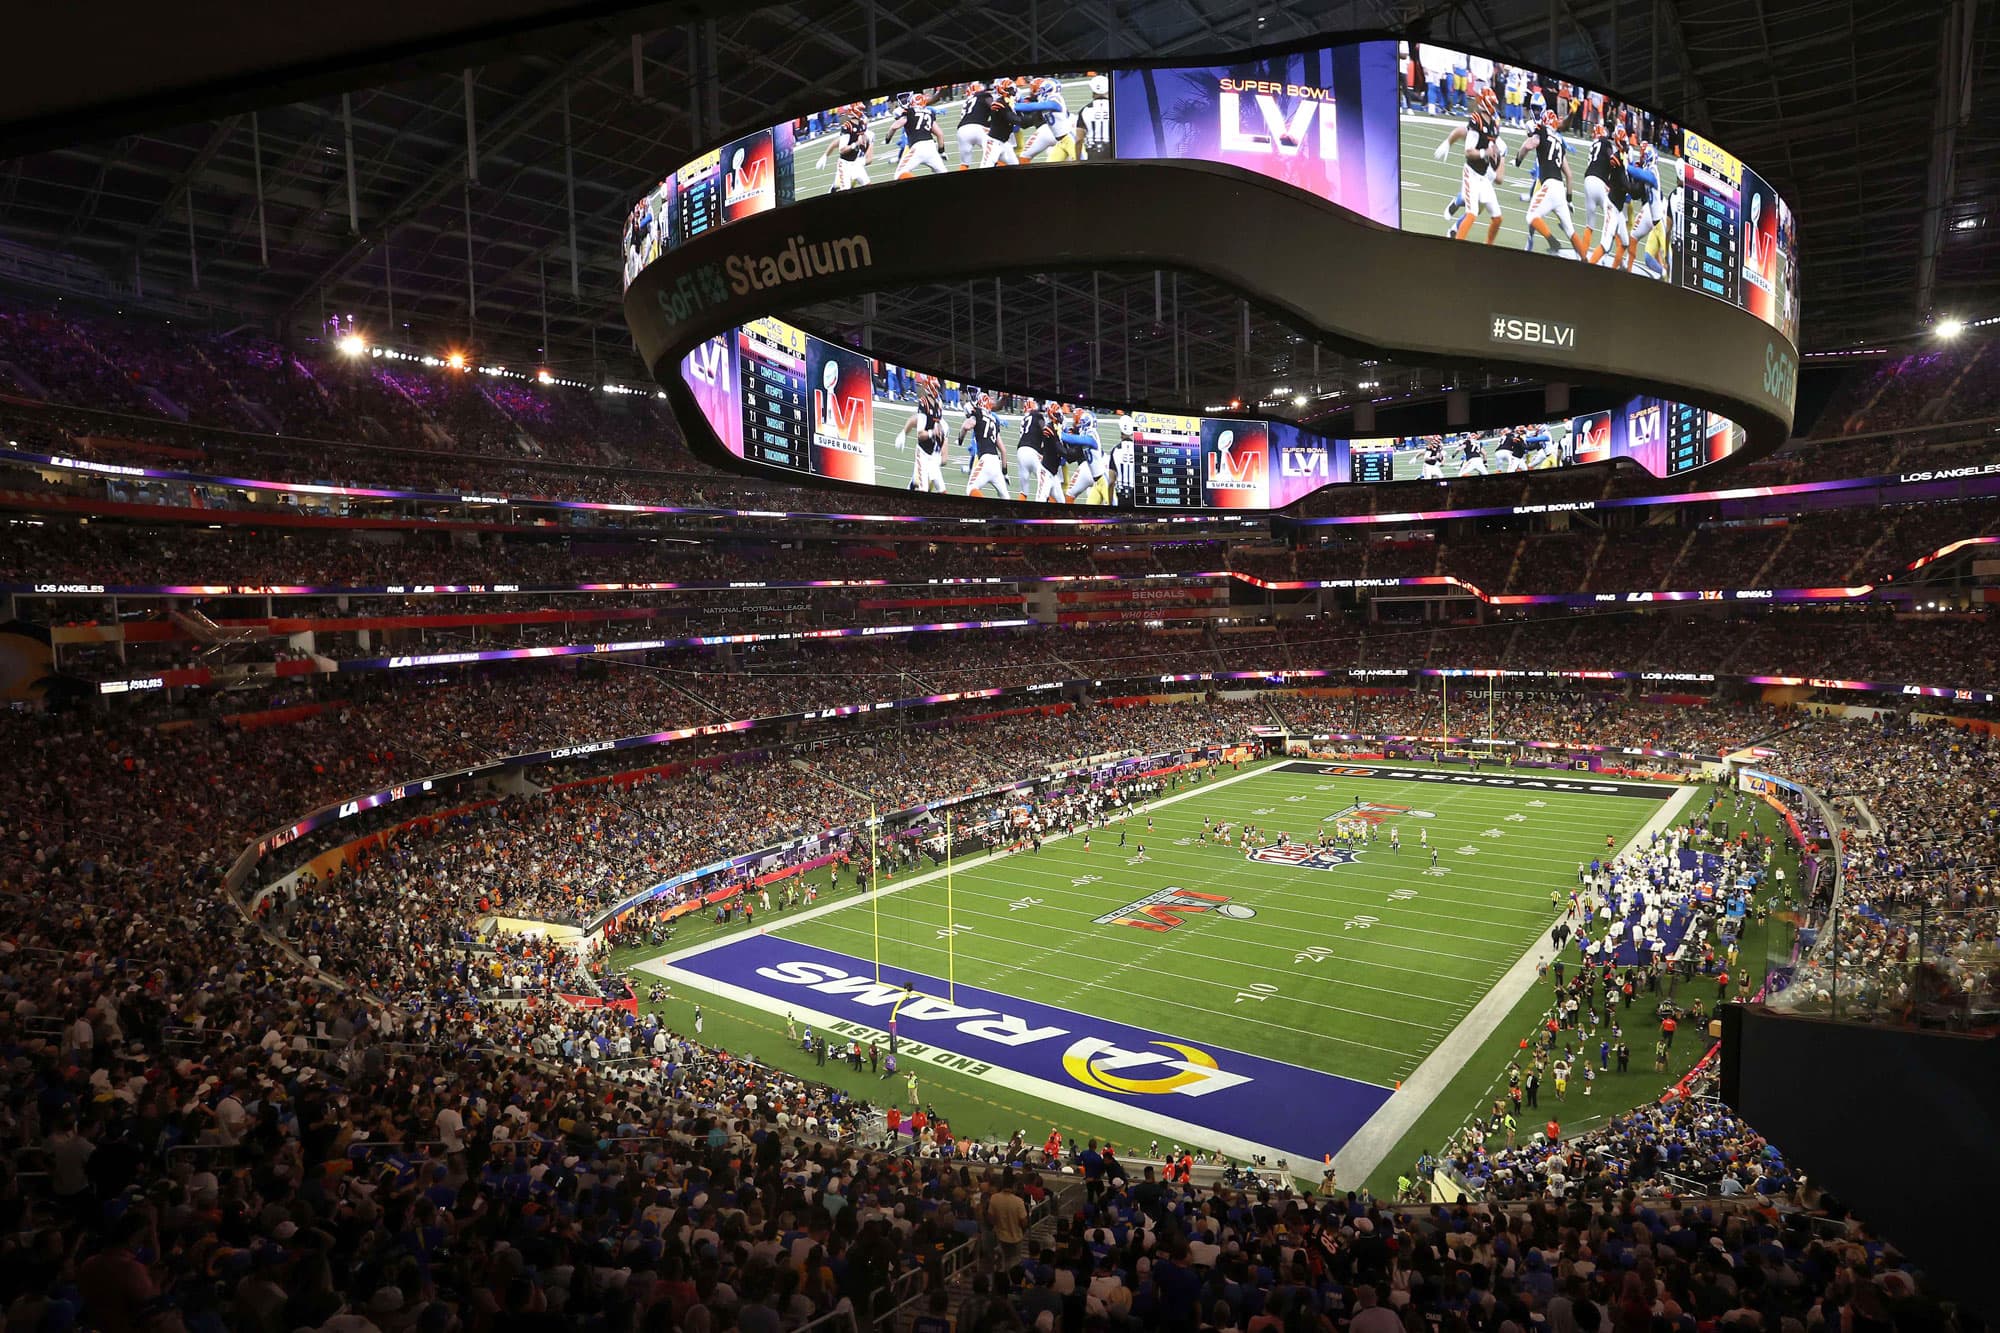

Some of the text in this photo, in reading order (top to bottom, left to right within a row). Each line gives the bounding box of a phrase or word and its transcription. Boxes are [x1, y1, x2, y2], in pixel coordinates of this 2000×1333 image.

[1220, 78, 1336, 102] SUPER BOWL
[915, 112, 932, 130] 73
[1219, 92, 1337, 160] LVI
[1547, 136, 1563, 168] 73
[1702, 145, 1725, 165] SACKS
[725, 157, 768, 198] LVI
[657, 235, 872, 327] SoFi Stadium
[1493, 317, 1575, 347] #SBLVI
[690, 338, 731, 394] LVI
[1764, 343, 1786, 401] SoFi
[760, 366, 786, 385] COMPLETIONS
[765, 383, 783, 399] ATTEMPTS
[815, 389, 866, 443] LVI
[1151, 416, 1177, 425] SACKS
[982, 416, 997, 444] 73
[1629, 411, 1660, 448] LVI
[818, 437, 862, 453] SUPER BOWL
[1154, 447, 1179, 455] COMPLETIONS
[89, 462, 121, 473] ANGELES
[1159, 457, 1176, 465] ATTEMPTS
[1208, 451, 1261, 482] LVI
[1282, 452, 1329, 477] LVI
[1901, 464, 2000, 482] LOS ANGELES
[1513, 501, 1595, 514] SUPER BOWL LVI
[35, 584, 104, 593] LOS ANGELES
[1320, 578, 1400, 588] SUPER BOWL LVI
[1132, 590, 1185, 599] BENGALS
[1736, 590, 1773, 599] BENGALS
[742, 605, 782, 613] FOOTBALL
[1120, 611, 1141, 619] WHO
[414, 656, 428, 665] LOS
[430, 654, 460, 664] ANGELES
[551, 741, 615, 759] LOS ANGELES
[1388, 772, 1618, 792] BENGALS
[1344, 915, 1380, 929] 30
[1294, 946, 1333, 962] 20
[1237, 983, 1279, 1001] 10
[755, 961, 1071, 1047] RAMS
[829, 1021, 930, 1056] RACISM
[932, 1053, 993, 1076] END
